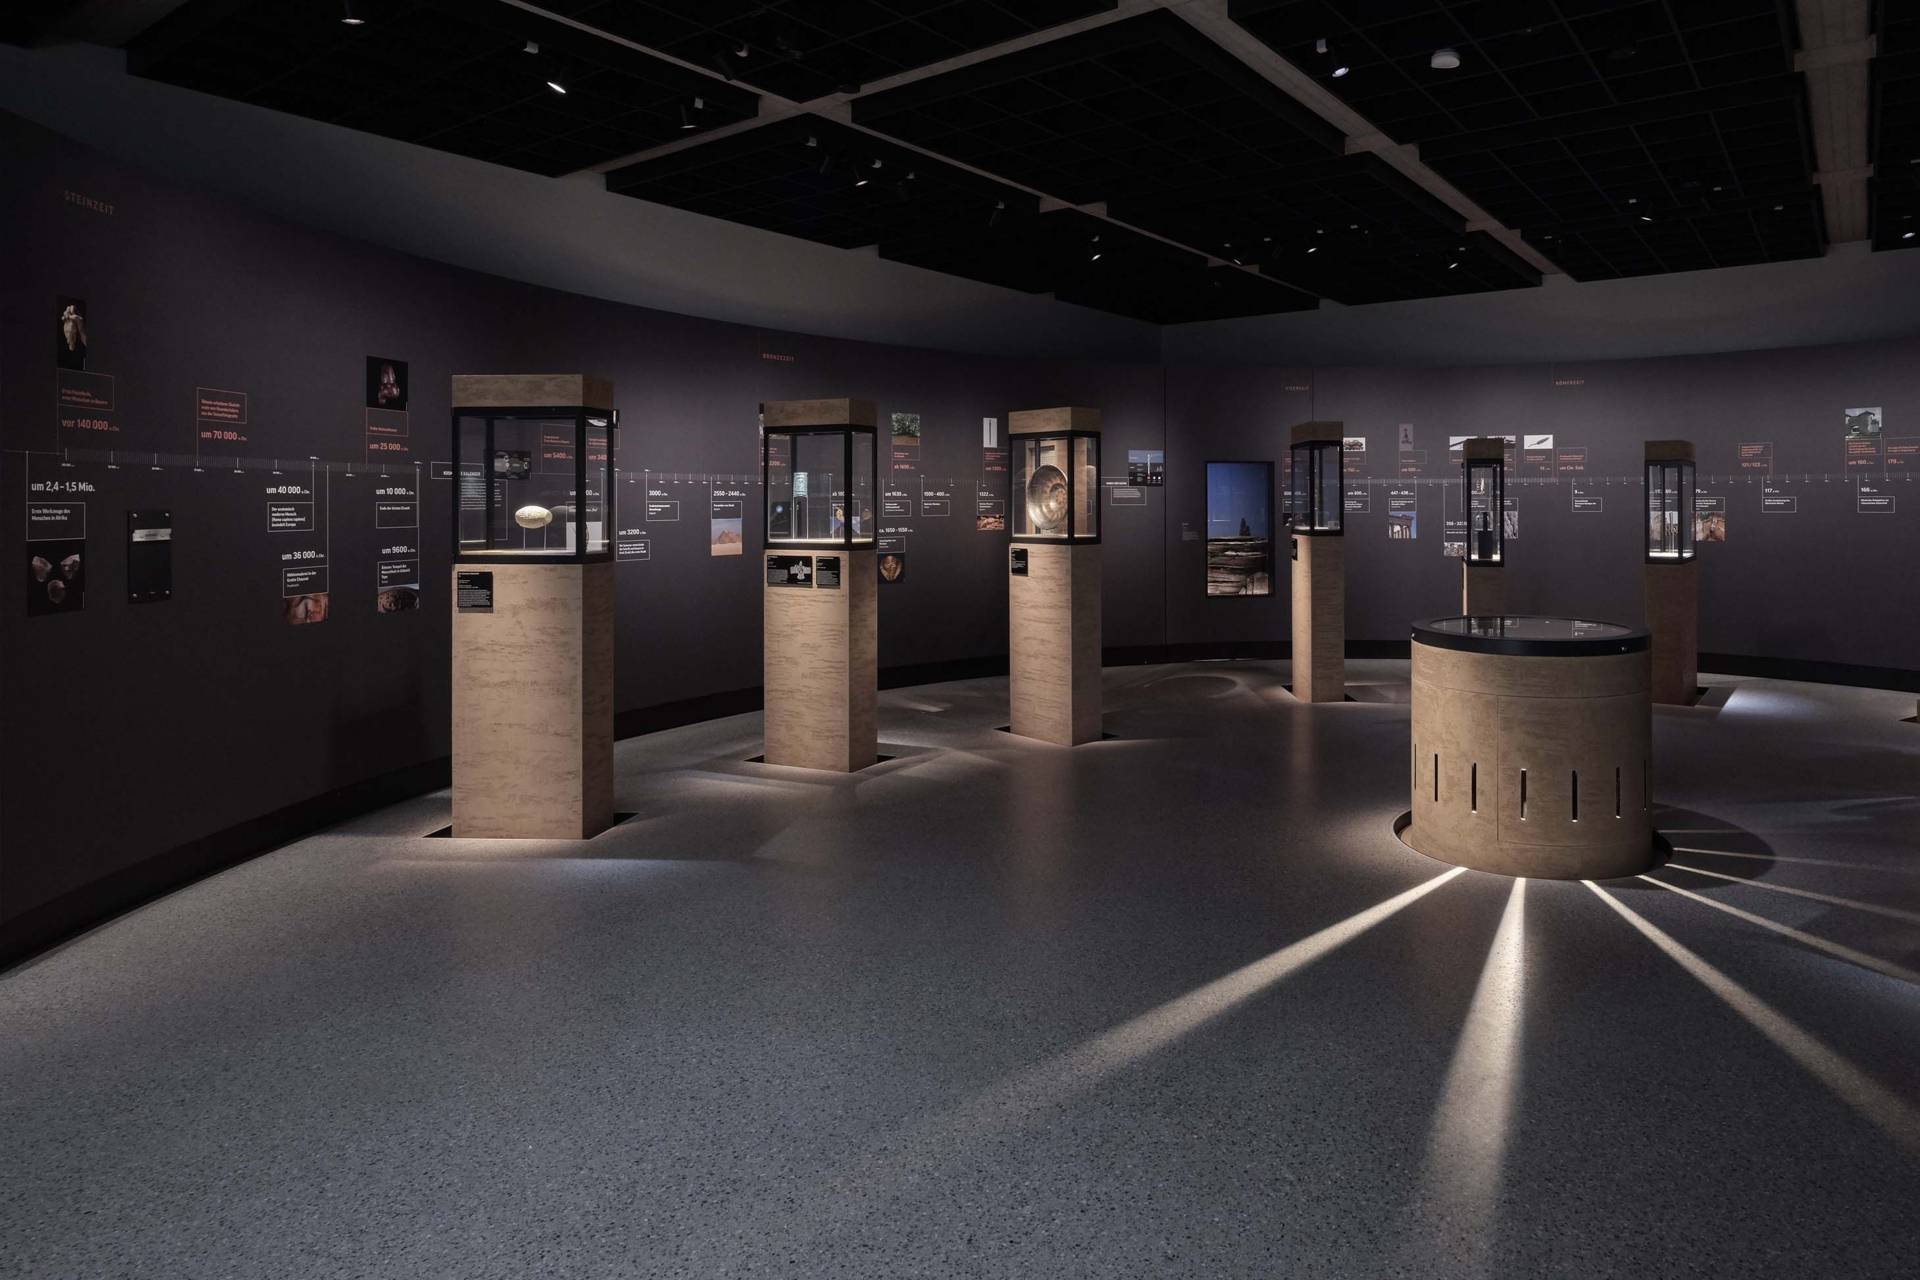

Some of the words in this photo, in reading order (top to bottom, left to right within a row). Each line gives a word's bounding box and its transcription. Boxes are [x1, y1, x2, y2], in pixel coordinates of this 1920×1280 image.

[200, 431, 212, 439] um
[212, 430, 222, 440] 70
[31, 482, 45, 491] um
[78, 482, 96, 492] Mio.
[278, 485, 287, 495] 40
[375, 488, 386, 496] um
